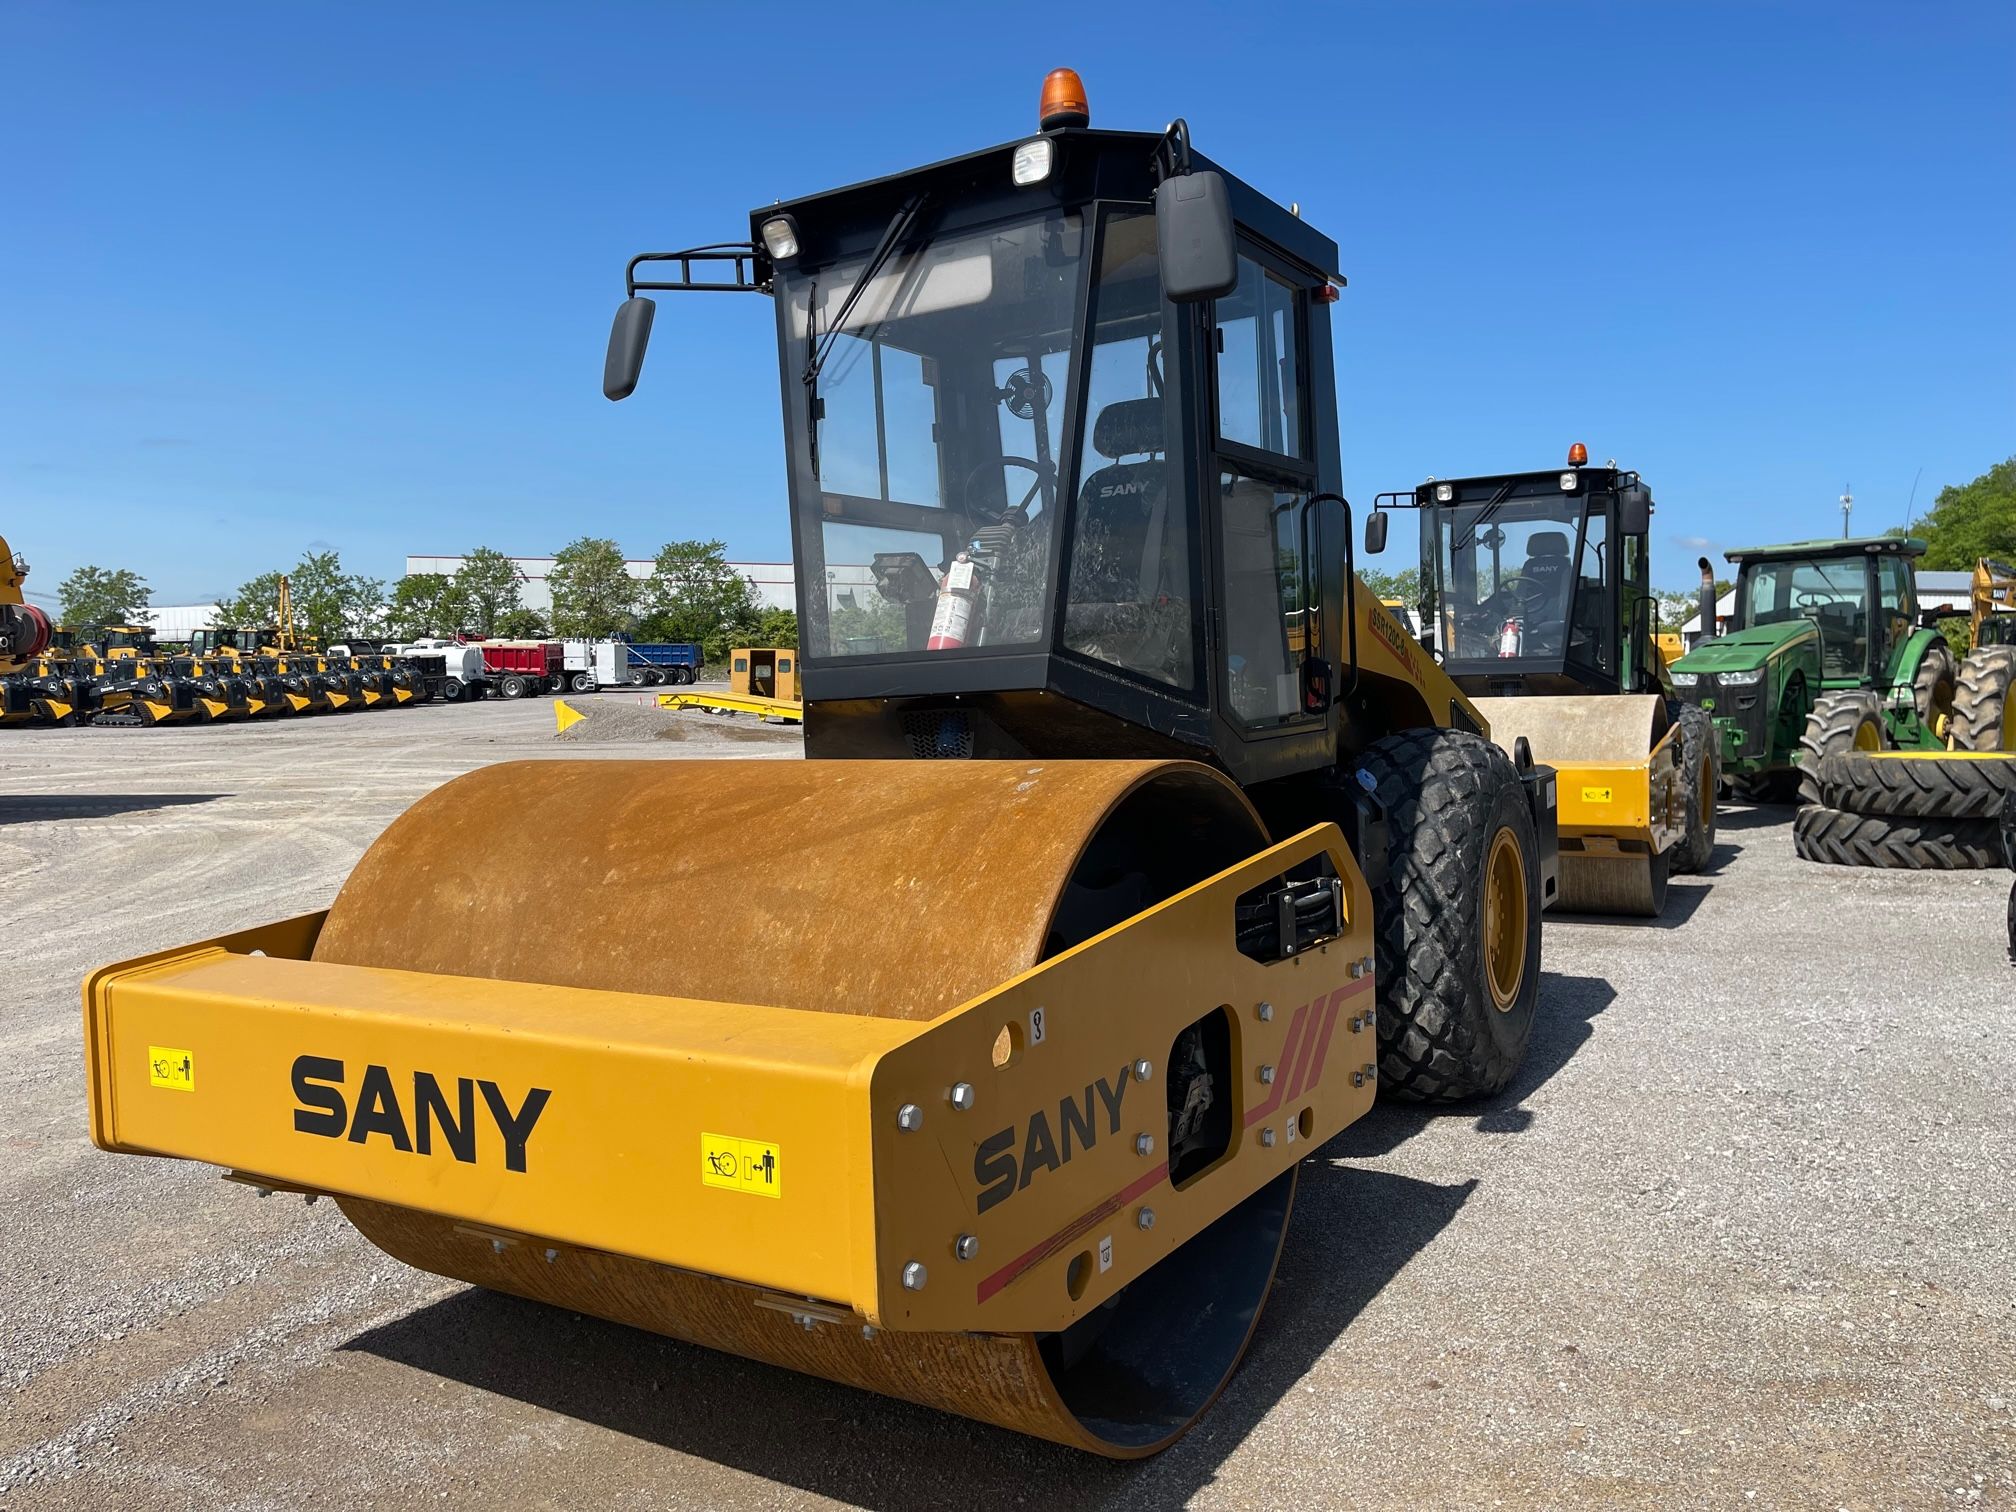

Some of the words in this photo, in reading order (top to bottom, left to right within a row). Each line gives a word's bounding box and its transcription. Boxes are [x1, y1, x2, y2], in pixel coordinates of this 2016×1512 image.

[1101, 481, 1149, 498] SANY
[291, 1055, 552, 1173] SANY
[974, 1064, 1130, 1215] SANY
